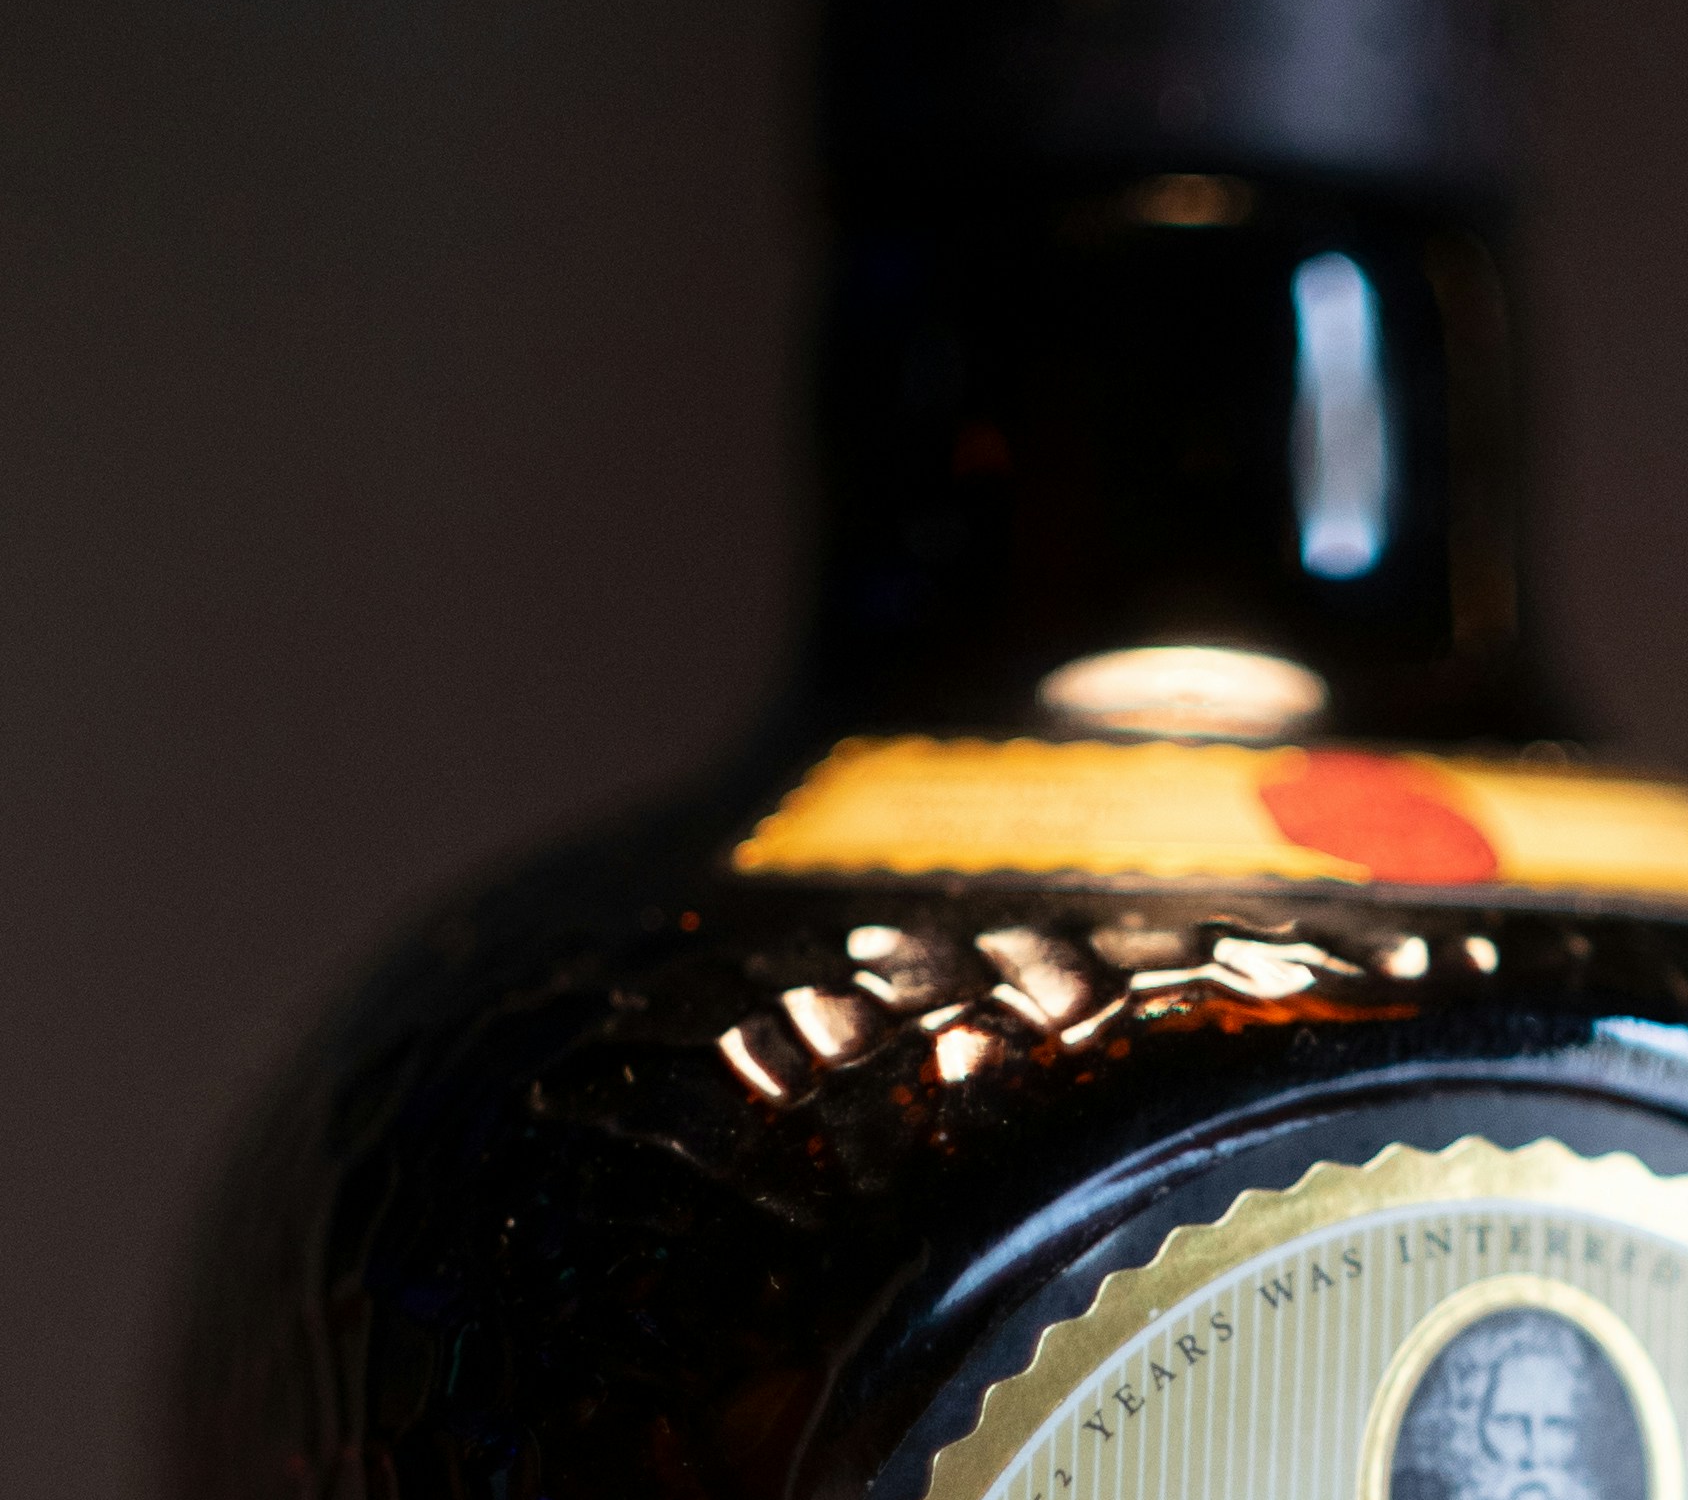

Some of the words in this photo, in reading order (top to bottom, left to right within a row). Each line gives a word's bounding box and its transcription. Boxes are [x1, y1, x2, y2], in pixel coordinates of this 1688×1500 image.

[1082, 1310, 1234, 1446] YEARS
[1256, 1246, 1364, 1311] WAS
[1396, 1218, 1683, 1292] INTERRED
